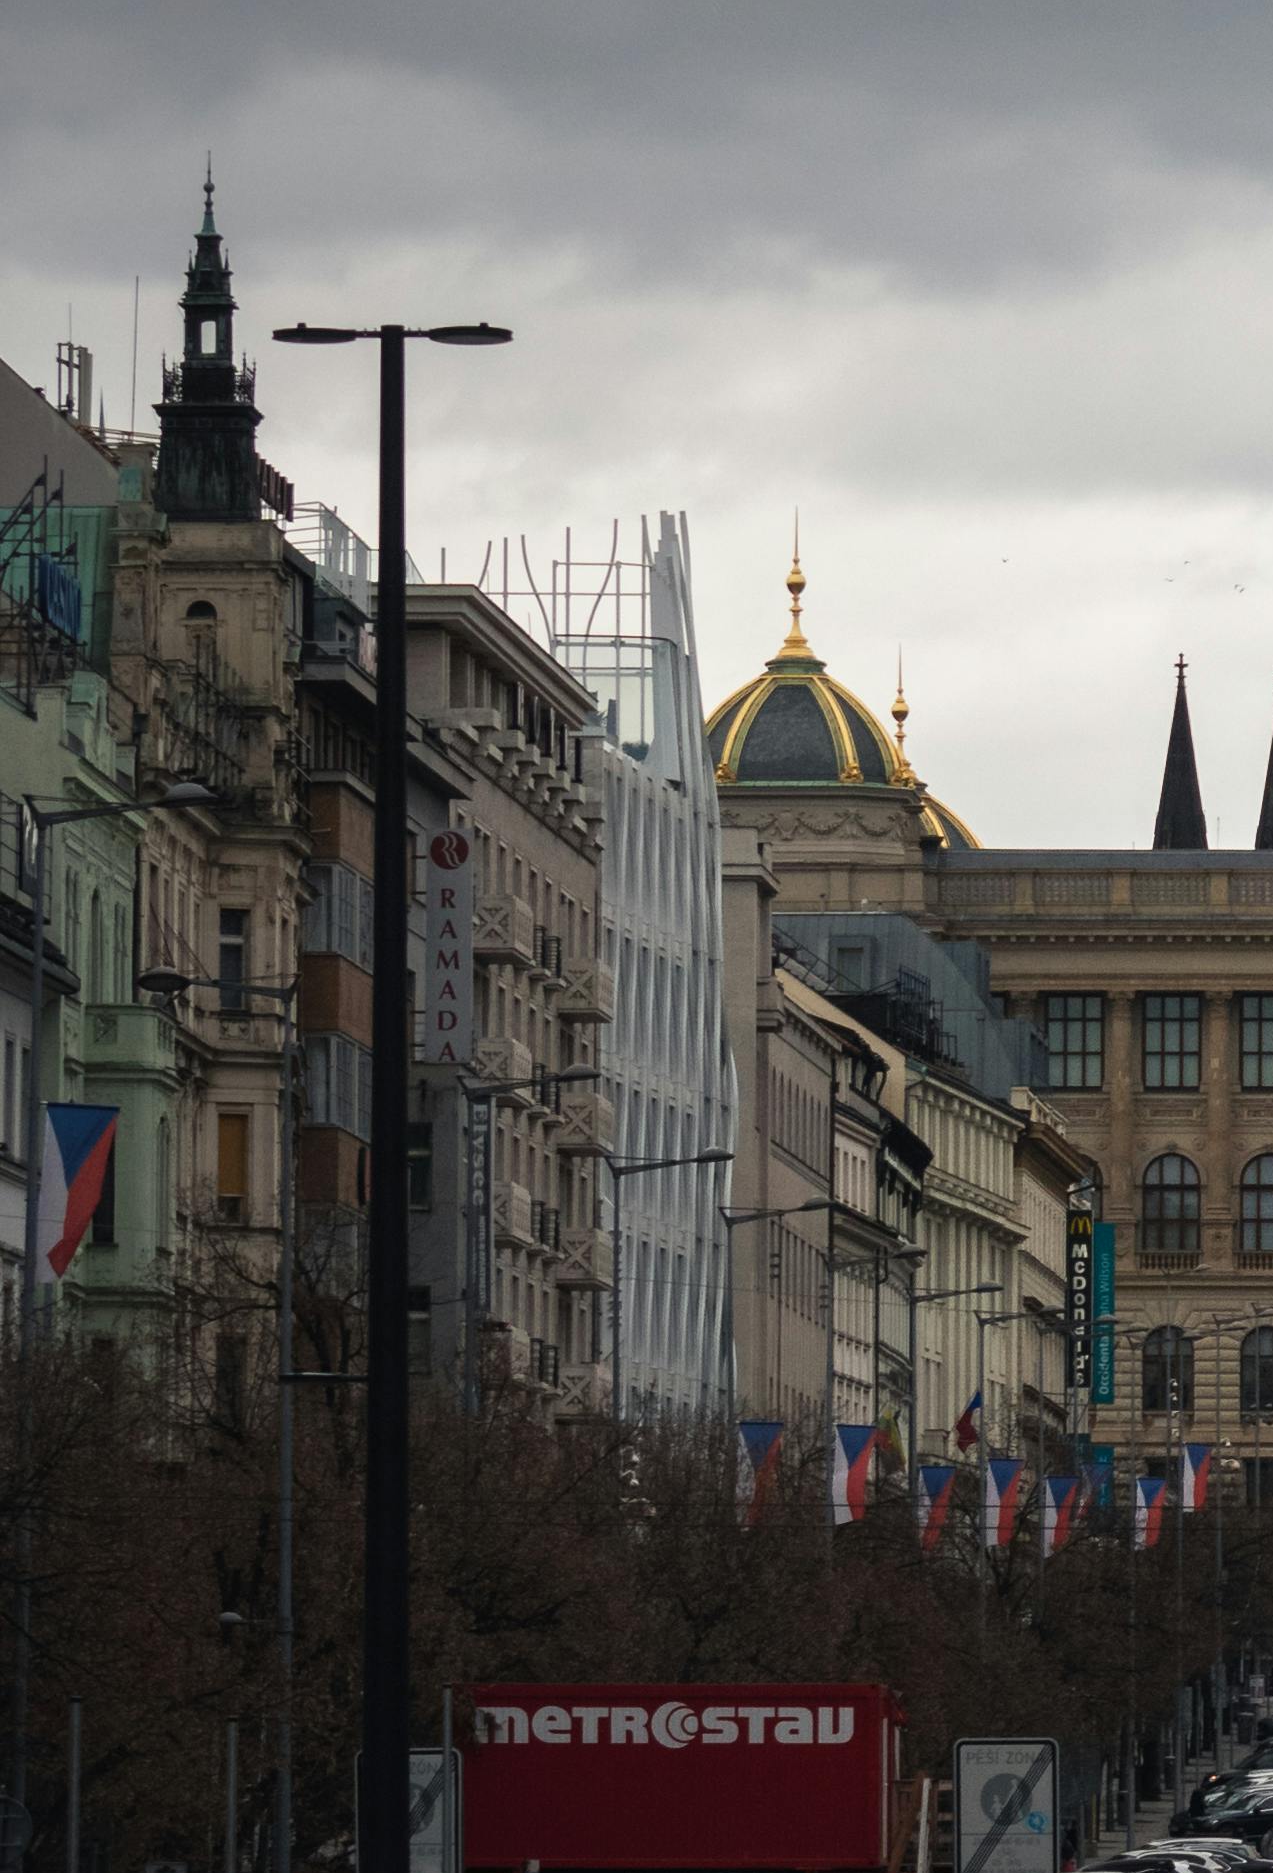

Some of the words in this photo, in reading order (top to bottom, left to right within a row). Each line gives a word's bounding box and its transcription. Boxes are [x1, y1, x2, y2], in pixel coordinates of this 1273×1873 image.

[435, 888, 460, 1062] RAMADA
[1098, 1330, 1110, 1395] Occidenta
[1006, 1748, 1036, 1765] ZÓN
